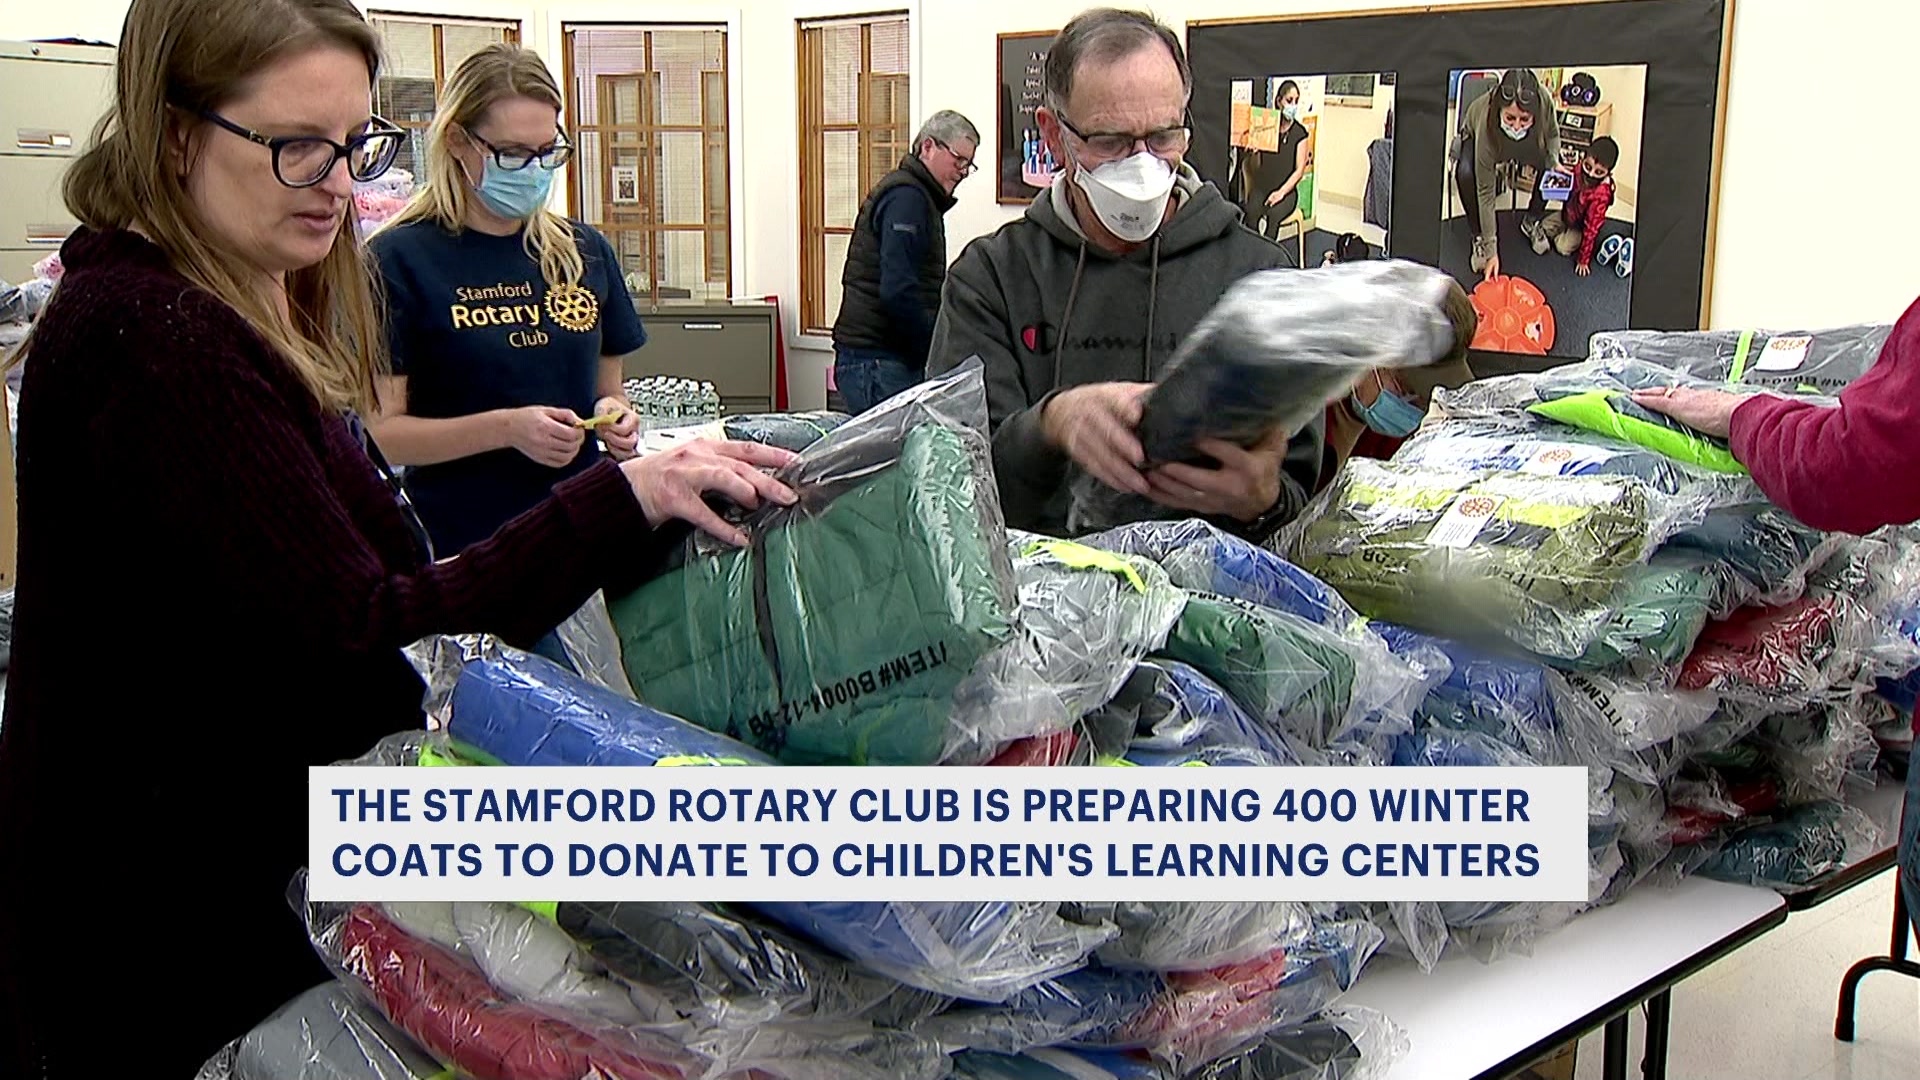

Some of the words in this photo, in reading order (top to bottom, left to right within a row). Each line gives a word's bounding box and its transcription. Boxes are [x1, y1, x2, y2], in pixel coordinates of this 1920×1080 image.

[455, 281, 533, 302] Stamford
[450, 303, 540, 329] Rotary
[508, 330, 549, 348] Club
